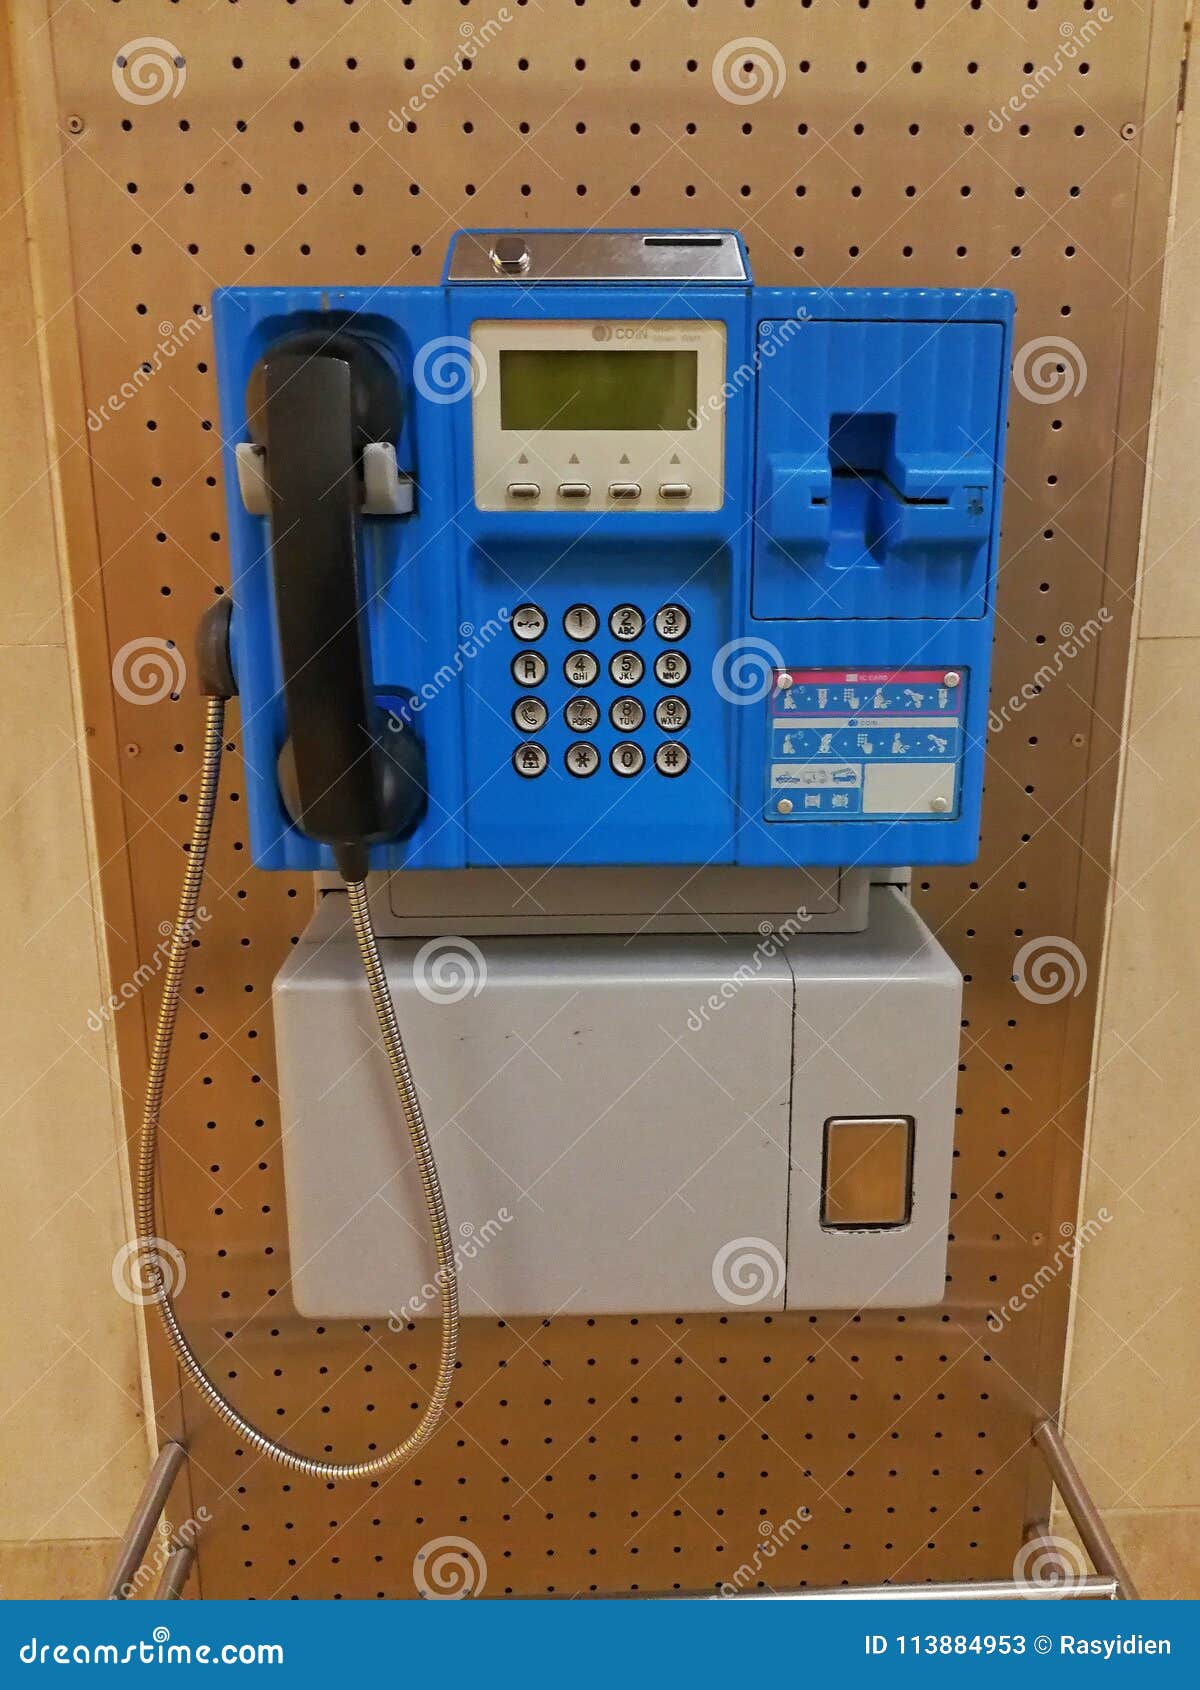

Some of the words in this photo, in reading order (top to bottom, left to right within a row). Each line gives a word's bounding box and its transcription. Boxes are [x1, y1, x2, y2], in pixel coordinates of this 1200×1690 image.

[574, 611, 584, 628] 1
[621, 611, 632, 626] 2
[666, 611, 677, 626] 3
[617, 626, 635, 635] ABC
[663, 626, 679, 635] DEF
[524, 660, 537, 679] R
[574, 658, 586, 672] 4
[621, 657, 632, 671] 5
[666, 657, 677, 671] 6
[572, 672, 588, 681] GHI
[618, 672, 635, 681] JKL
[662, 672, 681, 681] MNO
[576, 702, 587, 717] 7
[622, 702, 632, 717] 8
[666, 702, 677, 717] 9
[571, 717, 593, 726] PQRS
[619, 717, 635, 725] TUV
[660, 717, 682, 726] WXYZ
[621, 751, 634, 768] 0
[664, 750, 679, 767] #
